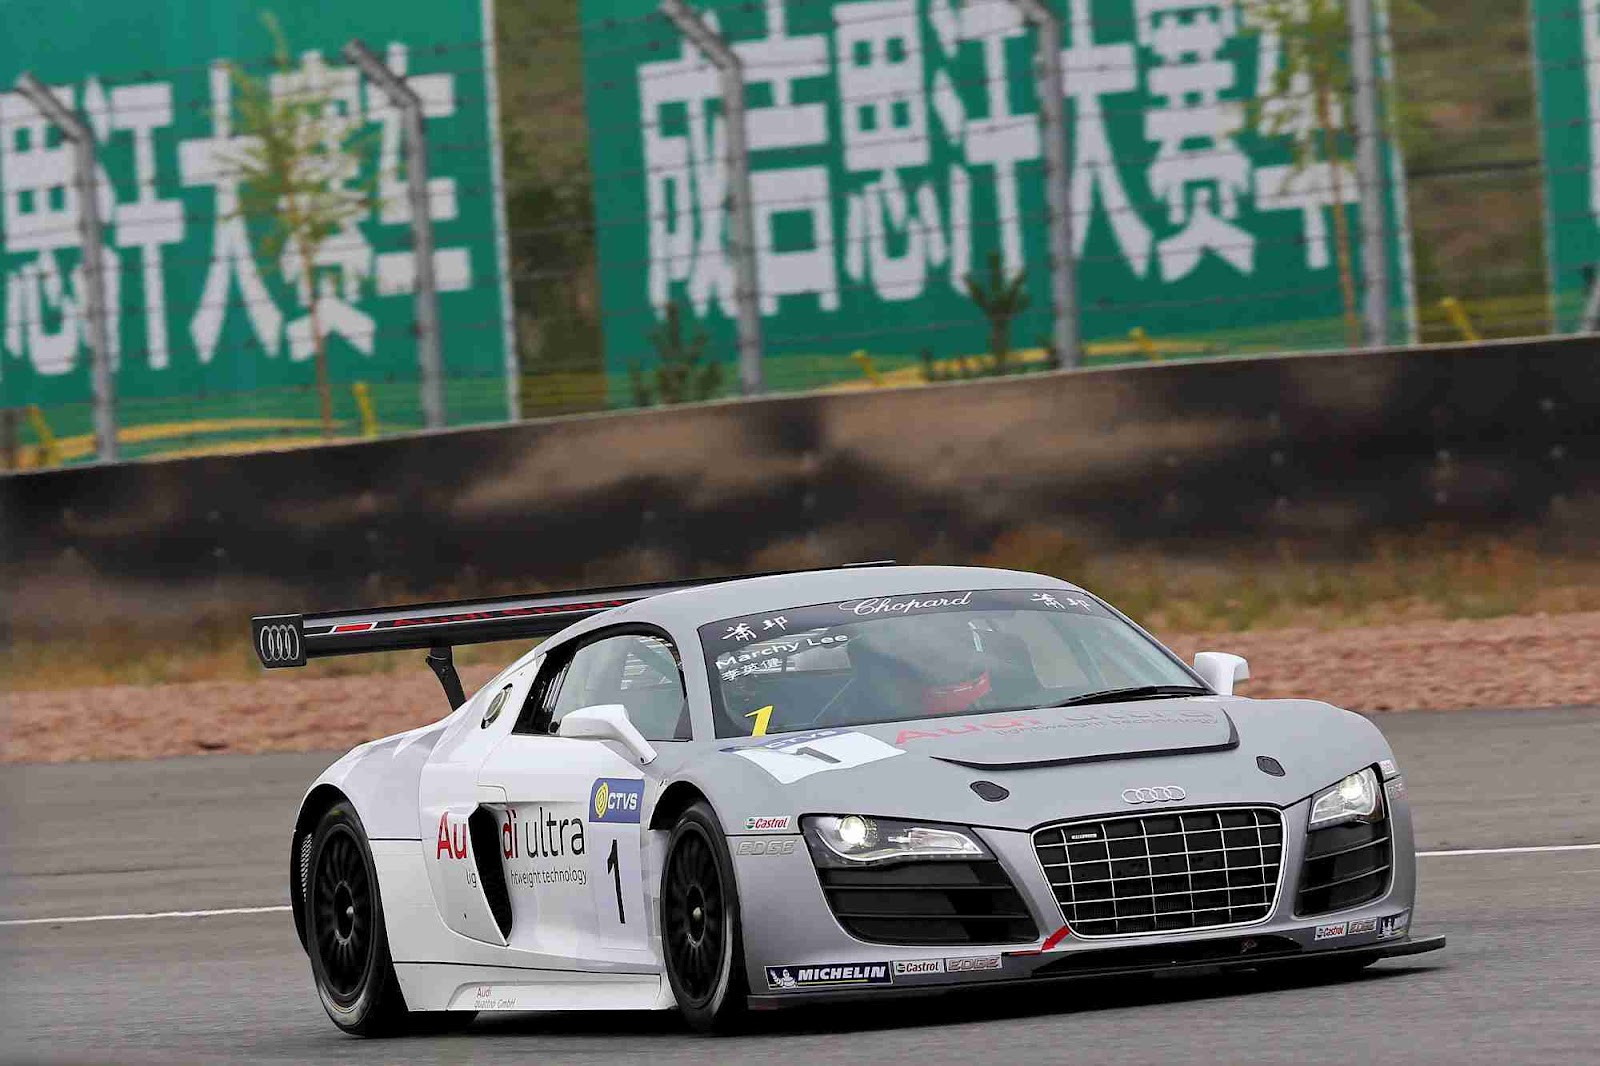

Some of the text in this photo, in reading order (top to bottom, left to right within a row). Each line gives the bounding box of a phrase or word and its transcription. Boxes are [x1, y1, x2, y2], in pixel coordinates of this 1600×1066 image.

[838, 592, 973, 615] Chopard
[715, 634, 848, 669] Marchy Lee
[744, 705, 774, 737] 1
[525, 806, 586, 858] ultra
[755, 818, 788, 829] Castrol
[735, 839, 797, 856] EDGE
[542, 865, 587, 885] technology
[606, 839, 626, 924] 1
[798, 966, 886, 981] MICHELIN
[906, 961, 940, 973] Castrol
